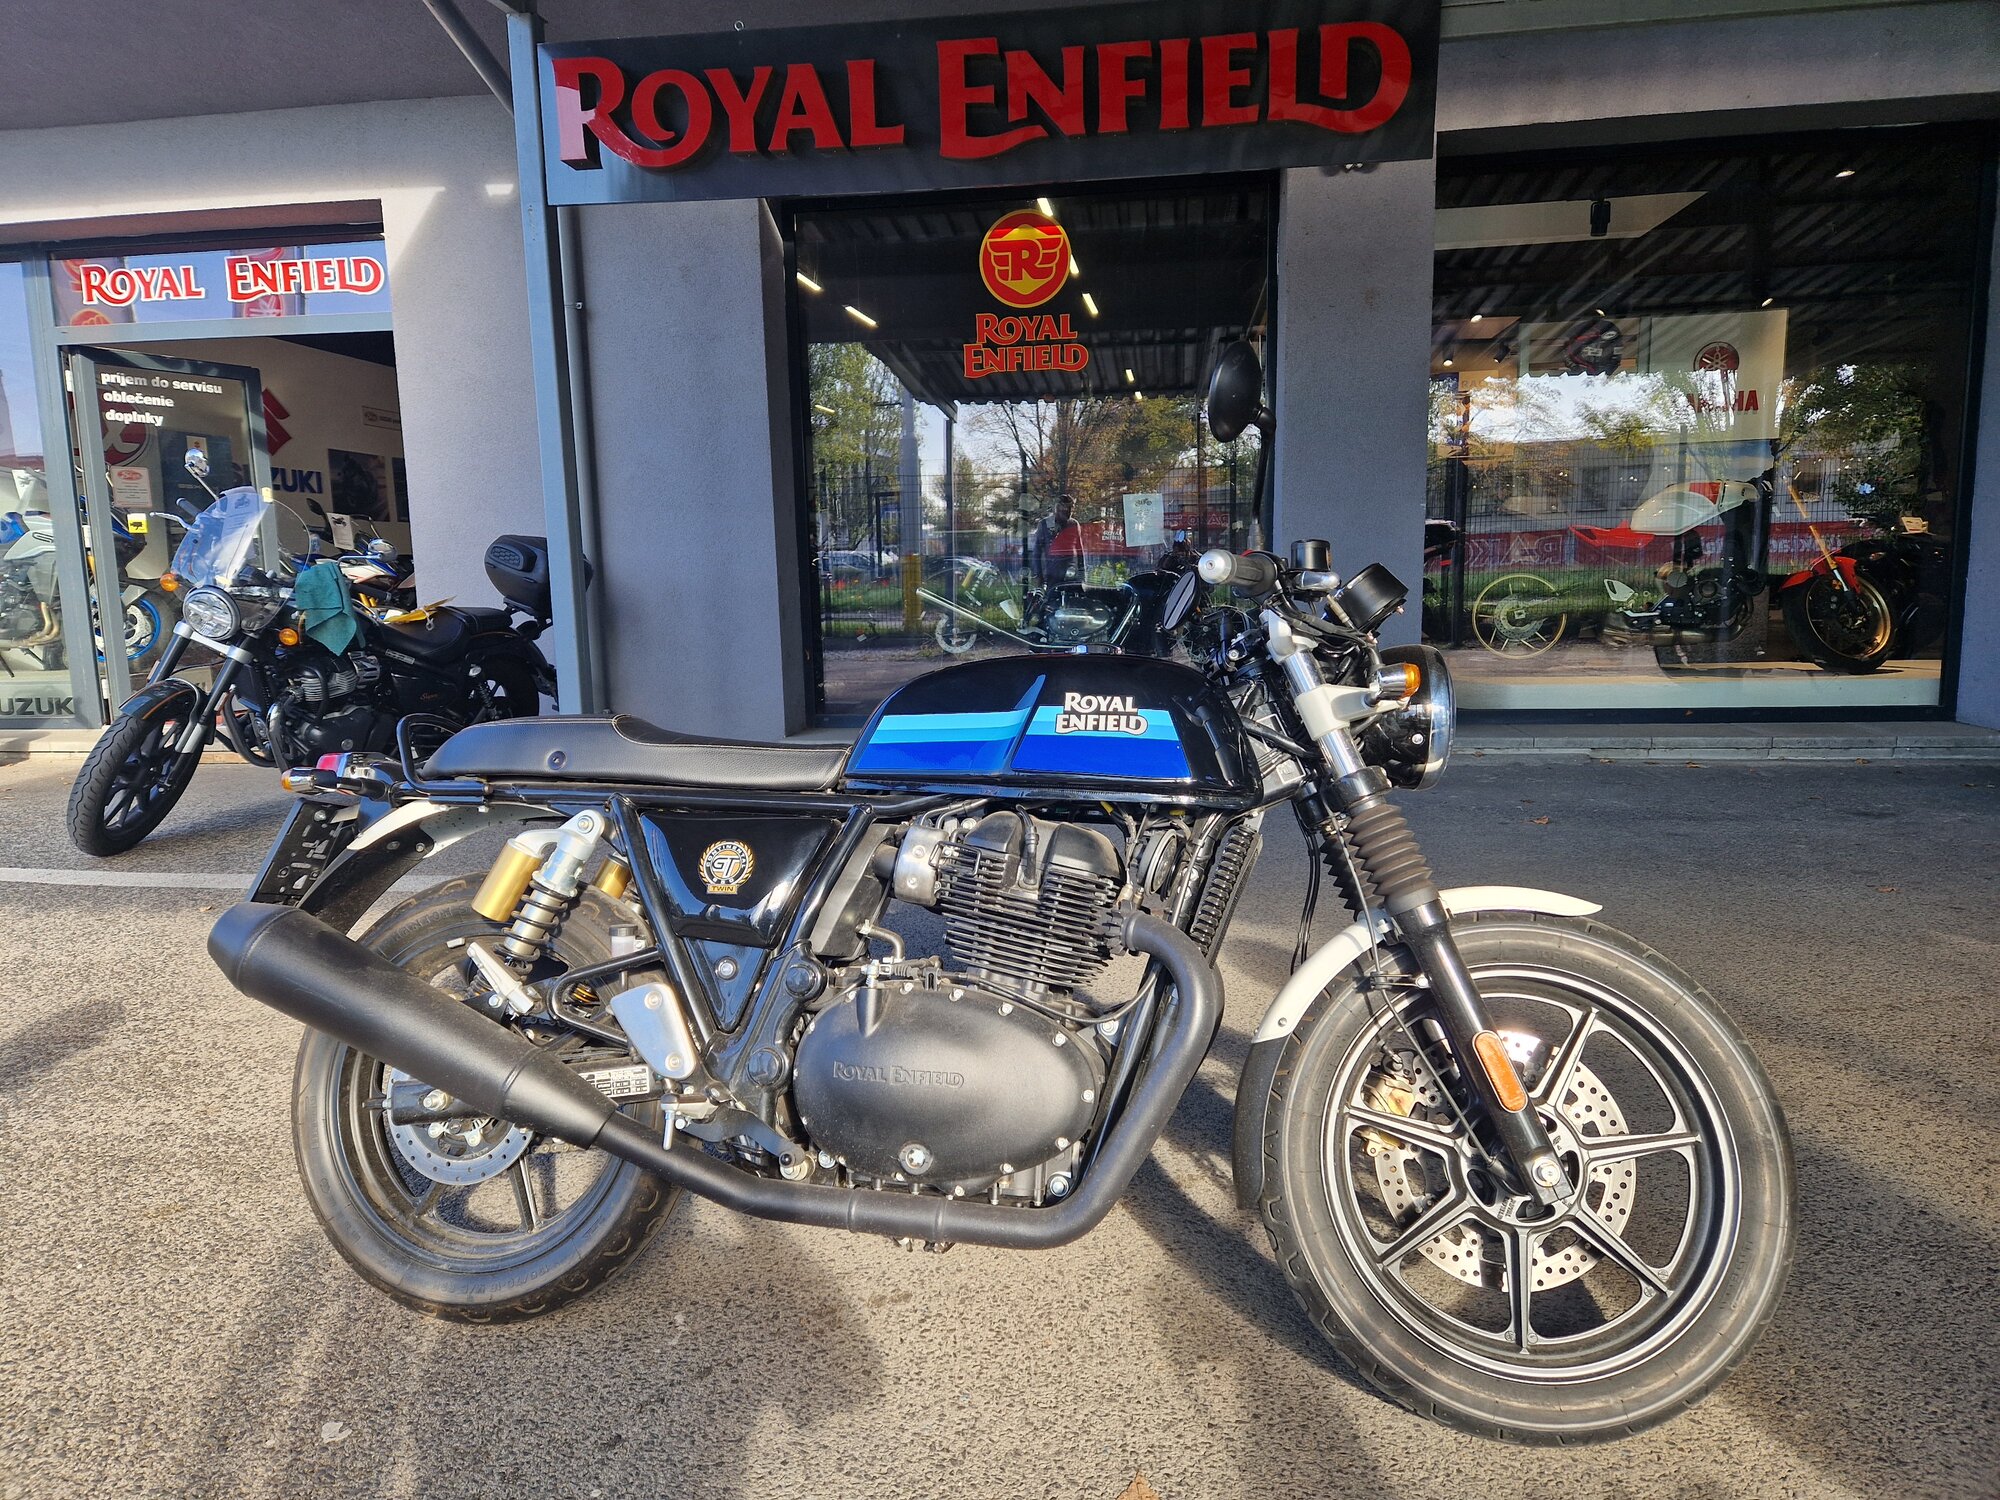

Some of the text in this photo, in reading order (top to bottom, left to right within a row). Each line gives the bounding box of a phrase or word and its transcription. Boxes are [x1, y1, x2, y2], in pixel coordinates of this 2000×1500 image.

[552, 21, 1412, 169] ROYAL ENFIELD
[80, 255, 385, 306] ROYAL ENFIELD
[975, 313, 1079, 345] ROYAL
[963, 343, 1089, 379] ENFIELD
[151, 376, 169, 388] do
[172, 380, 223, 394] servisu
[103, 390, 174, 407] oblečenie
[105, 409, 164, 427] doplnky
[1063, 692, 1138, 713] ROYAL
[1055, 714, 1148, 735] ENFIELD
[706, 844, 747, 867] CONTINENTAL
[711, 856, 741, 878] GT
[832, 1060, 965, 1088] ROYAL ENFIELD
